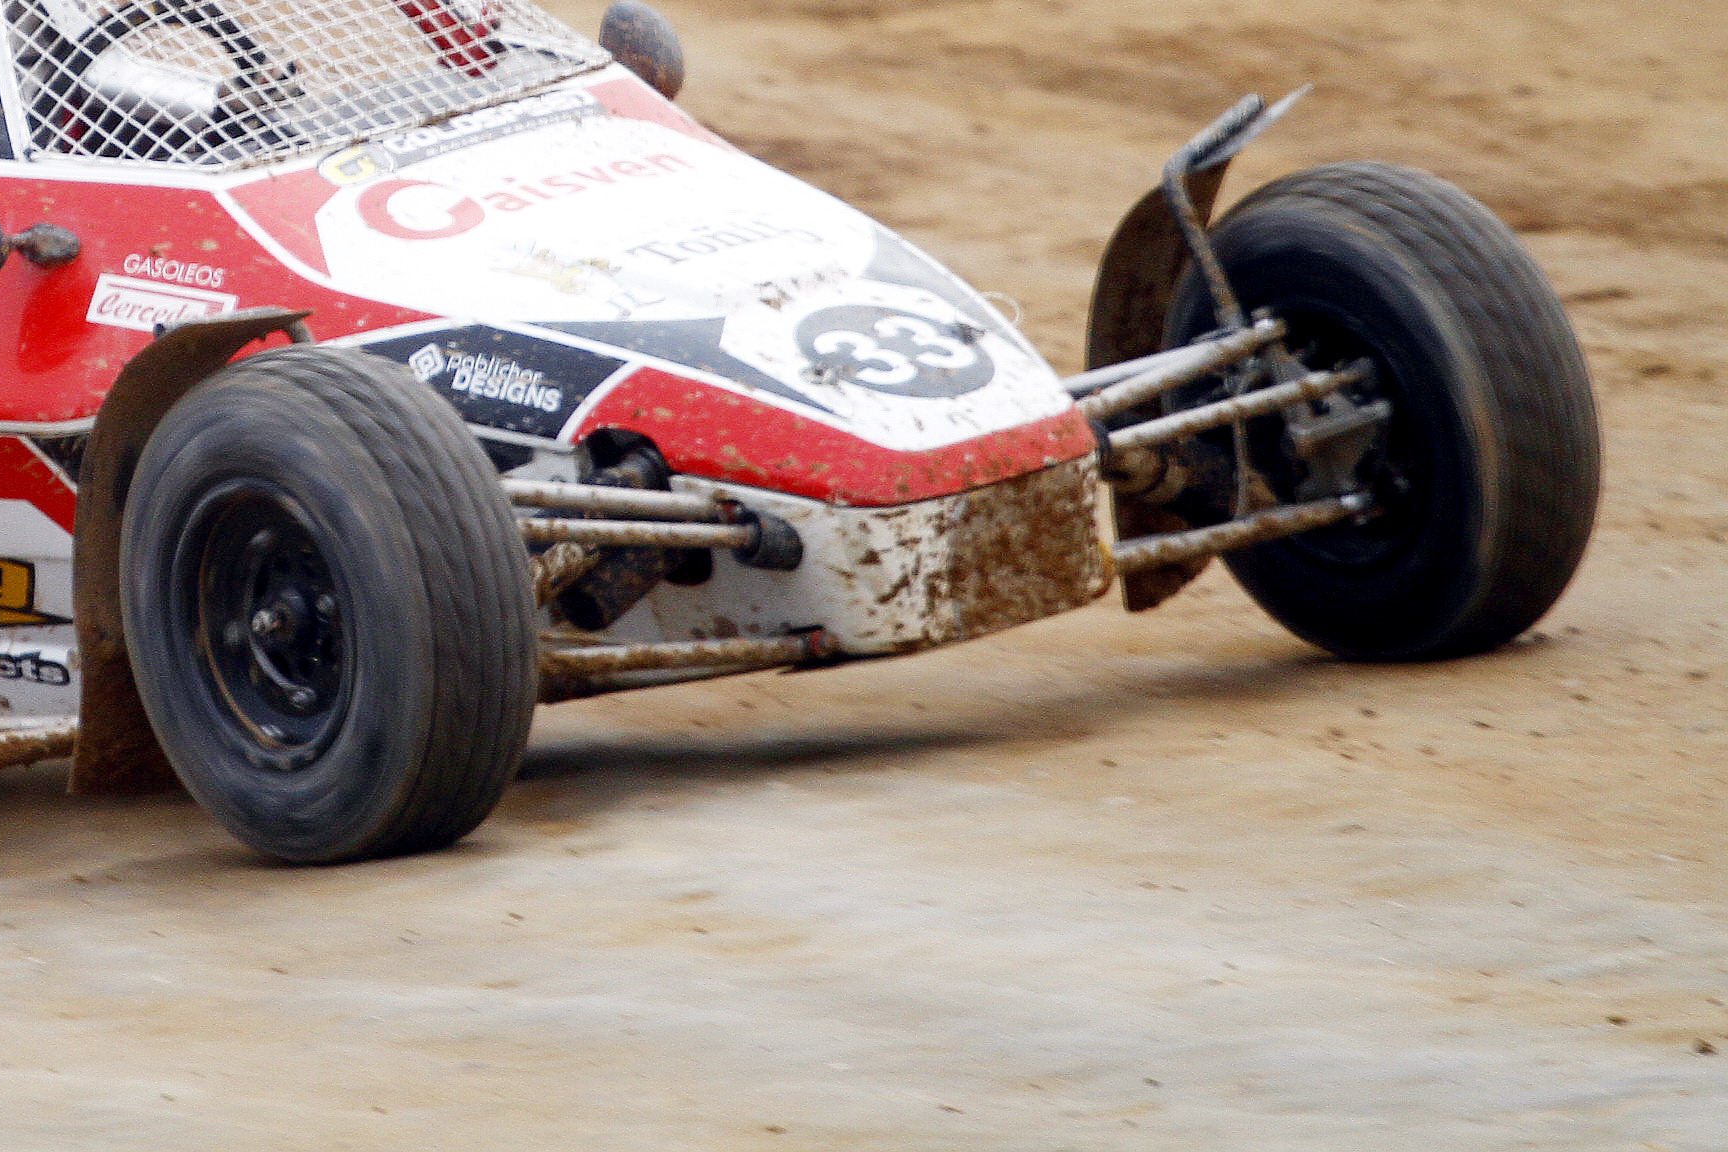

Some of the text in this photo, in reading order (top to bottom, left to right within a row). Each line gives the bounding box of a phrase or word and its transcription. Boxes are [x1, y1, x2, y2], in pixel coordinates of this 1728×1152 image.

[123, 253, 225, 288] GASOLEOS
[813, 315, 980, 385] 33
[450, 366, 564, 413] DESIGNS
